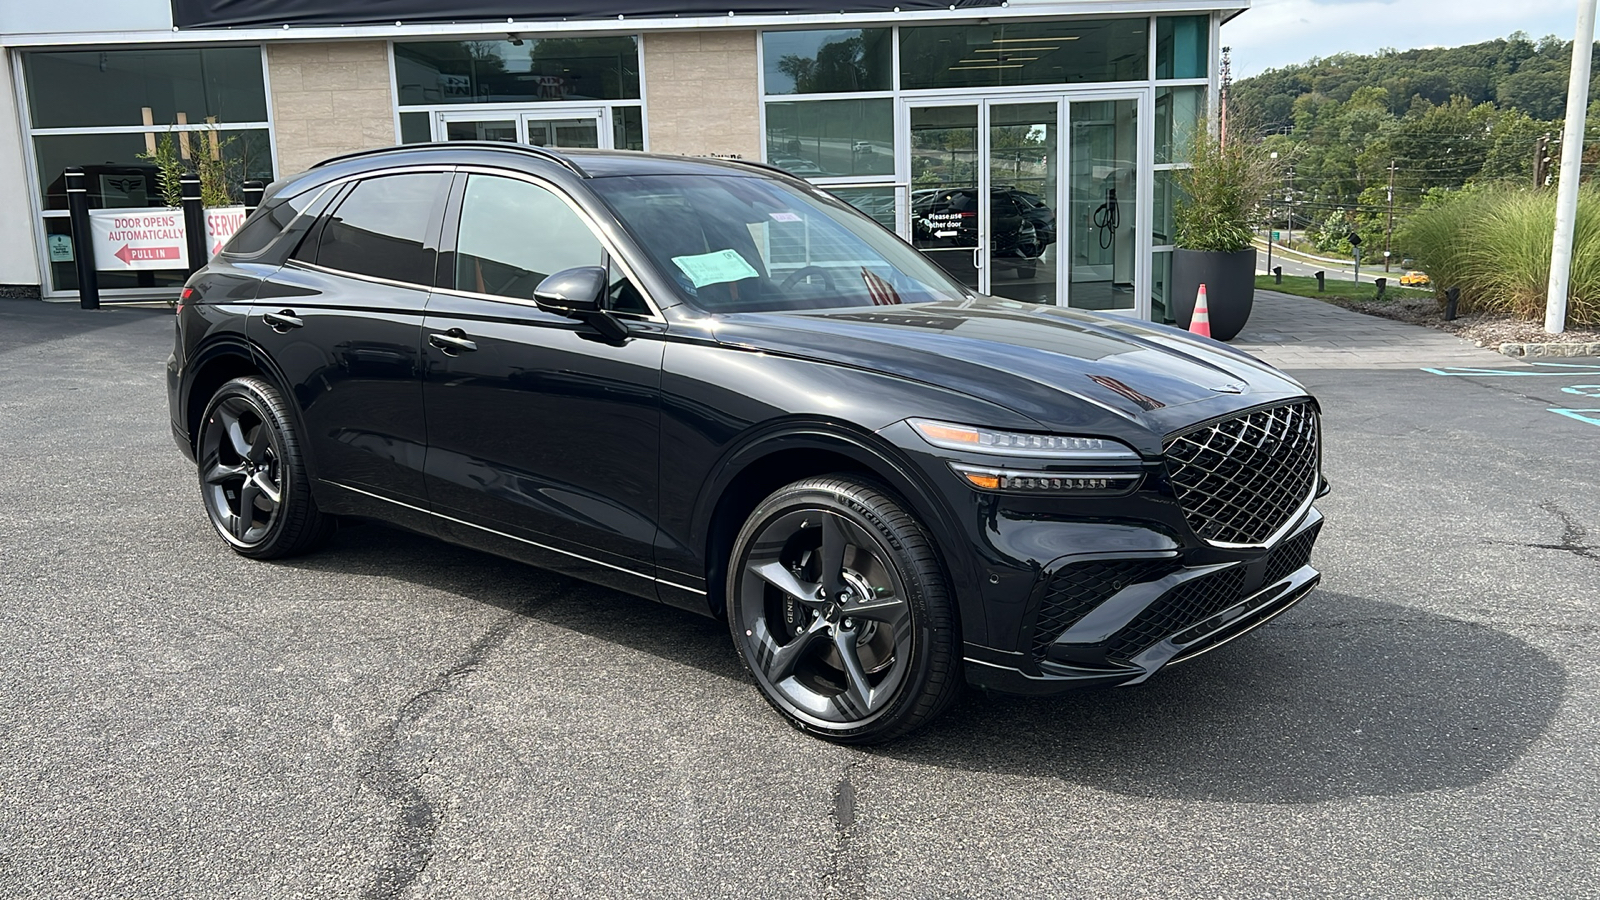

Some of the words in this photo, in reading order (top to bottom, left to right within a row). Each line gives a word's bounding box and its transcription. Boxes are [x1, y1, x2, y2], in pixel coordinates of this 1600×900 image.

[114, 218, 142, 228] DOOR
[143, 216, 175, 228] OPENS
[108, 228, 184, 241] AUTOMATICALLY
[131, 250, 153, 259] PULL
[155, 249, 166, 258] IN
[851, 503, 901, 549] MICHELIN
[786, 594, 794, 624] GENES
